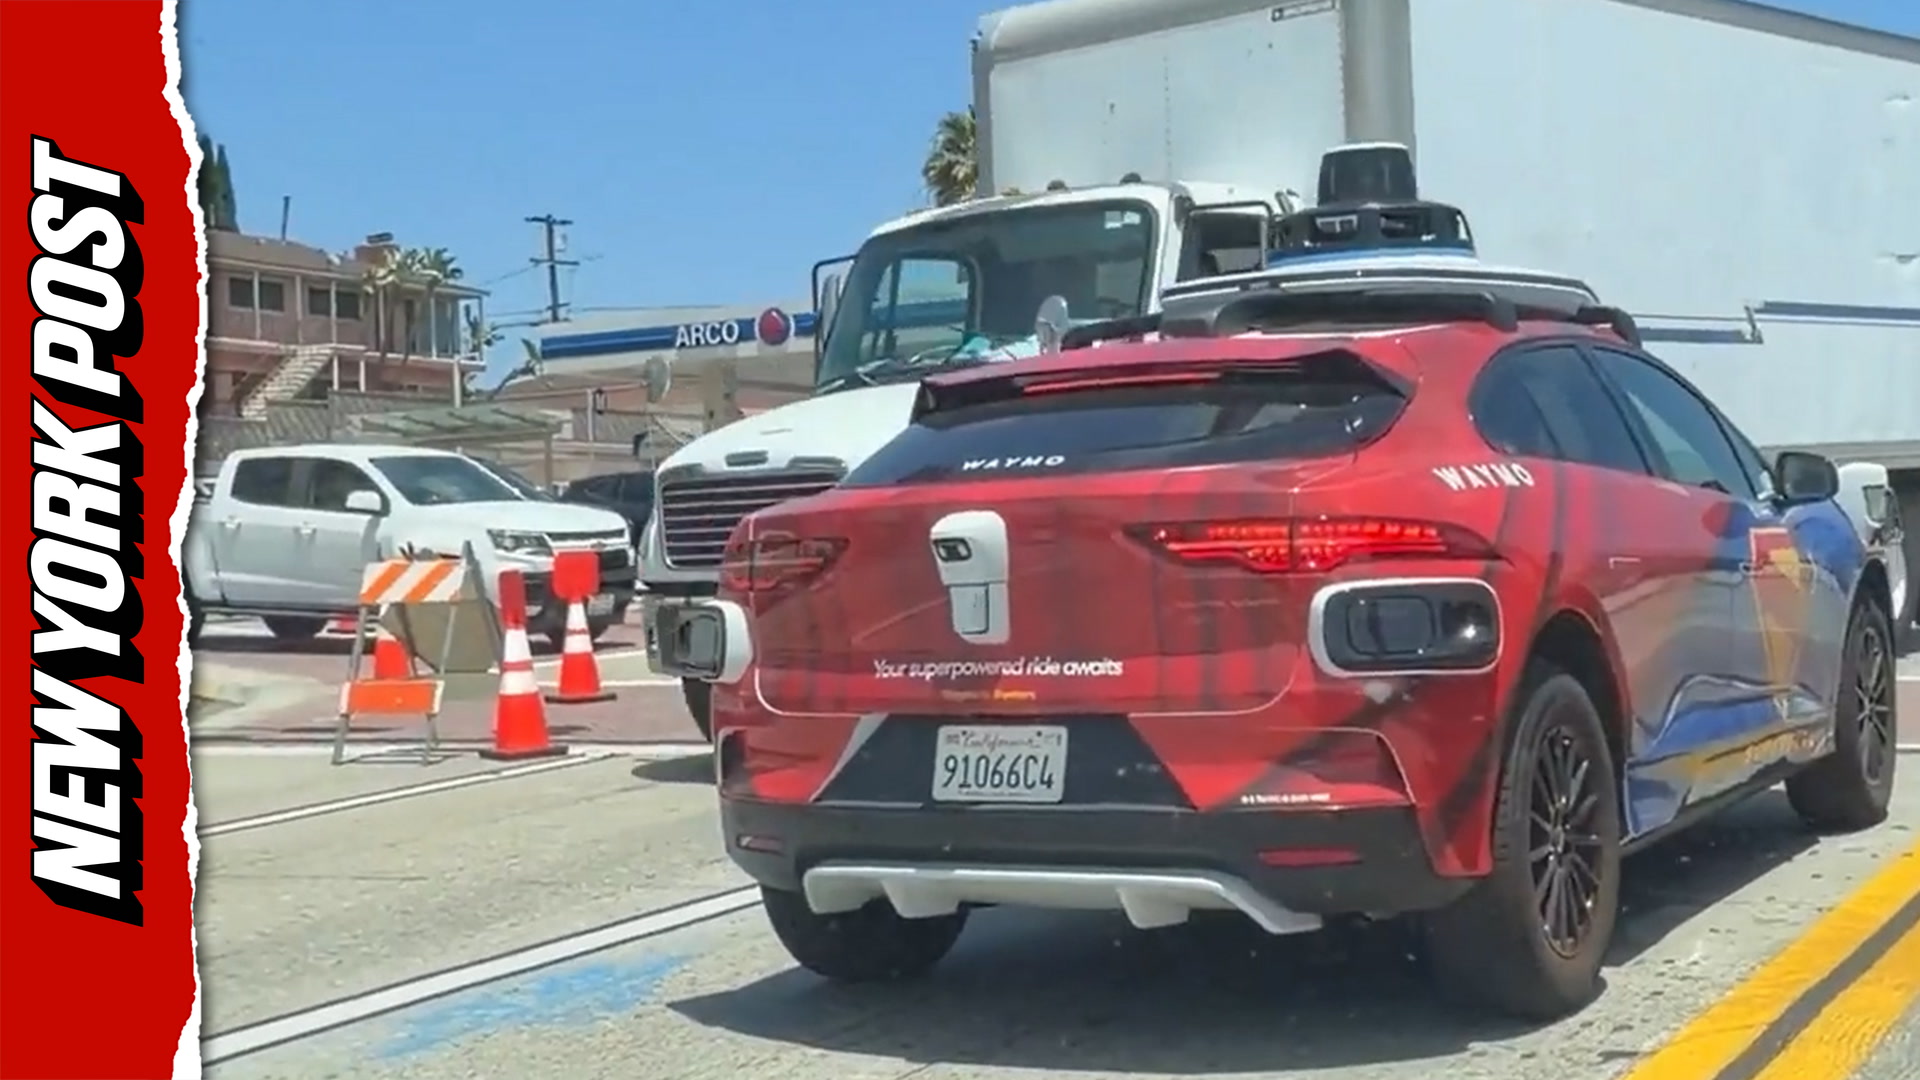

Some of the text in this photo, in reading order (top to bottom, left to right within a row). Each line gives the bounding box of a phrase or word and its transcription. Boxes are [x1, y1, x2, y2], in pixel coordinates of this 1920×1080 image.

[676, 321, 739, 347] ARCO
[962, 455, 1066, 471] WAYMO
[1431, 463, 1535, 491] WAYMO
[873, 657, 1124, 680] Your superpowered ride awaits
[942, 754, 1054, 789] 91066C4
